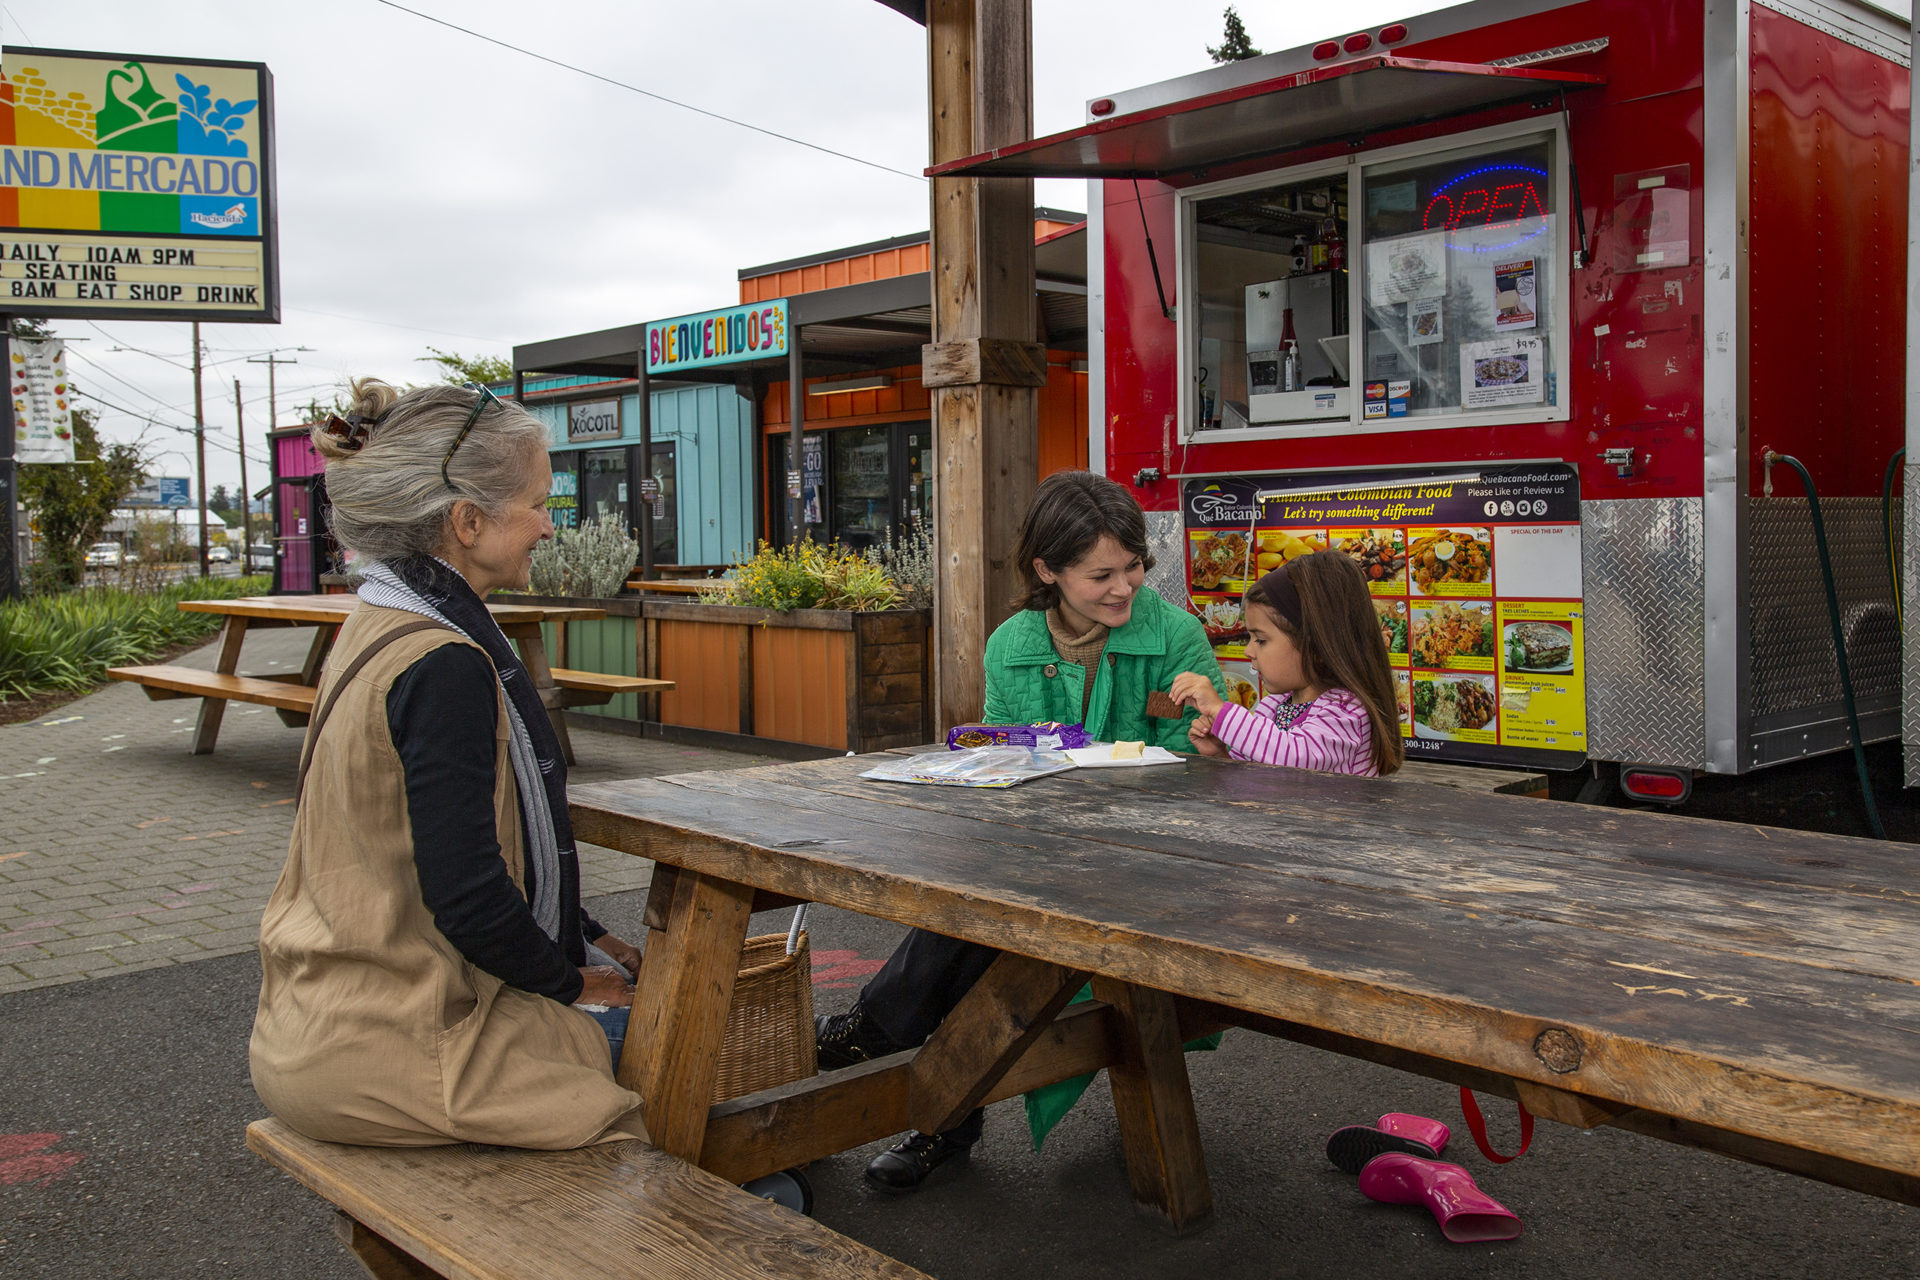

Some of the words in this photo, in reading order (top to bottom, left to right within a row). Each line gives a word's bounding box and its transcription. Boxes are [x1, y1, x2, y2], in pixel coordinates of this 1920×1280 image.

[0, 149, 60, 187] ND
[69, 152, 258, 196] MERCADO
[191, 213, 243, 223] Hacienda
[1424, 182, 1550, 235] OPEN
[88, 246, 142, 264] 10AM
[153, 249, 195, 266] 9PM
[25, 262, 117, 281] SEATING
[1496, 262, 1526, 272] DELIVERY
[11, 281, 57, 299] 8AM
[77, 283, 118, 300] EAT
[130, 284, 182, 301] SHOP
[197, 286, 259, 304] DRINK
[650, 308, 773, 367] BIENVENIDOS
[1368, 405, 1384, 414] VISA
[1416, 483, 1454, 499] Food
[1468, 488, 1494, 497] Please
[1495, 487, 1511, 496] Like
[1524, 486, 1553, 495] Review
[1199, 513, 1214, 524] Qué
[1215, 505, 1266, 521] Bacano!
[1284, 507, 1307, 519] Let's
[1308, 509, 1324, 522] try
[1326, 506, 1380, 521] something
[1382, 503, 1435, 521] different!
